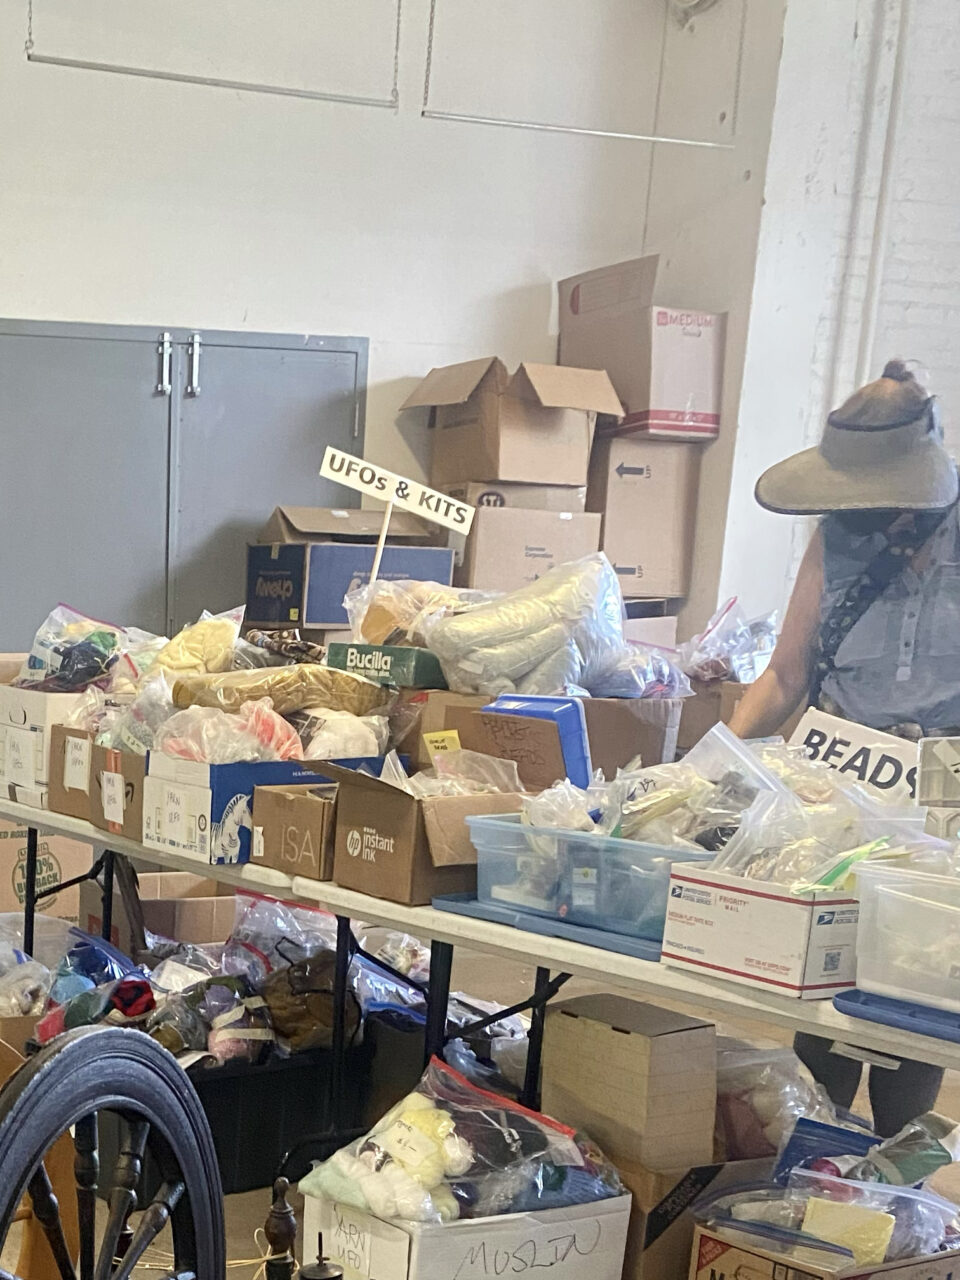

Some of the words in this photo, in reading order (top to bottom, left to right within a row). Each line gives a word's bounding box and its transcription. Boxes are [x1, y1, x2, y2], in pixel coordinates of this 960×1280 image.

[329, 453, 388, 491] UFOs
[395, 480, 410, 501] &
[418, 491, 467, 524] KITS
[346, 647, 391, 670] Bucilla
[10, 830, 30, 839] BOXE
[347, 830, 361, 857] hp
[363, 832, 395, 853] instant
[18, 854, 54, 879] 10%
[719, 895, 747, 907] PRIORITY
[725, 904, 739, 912] MAIL
[333, 1203, 365, 1253] YARN
